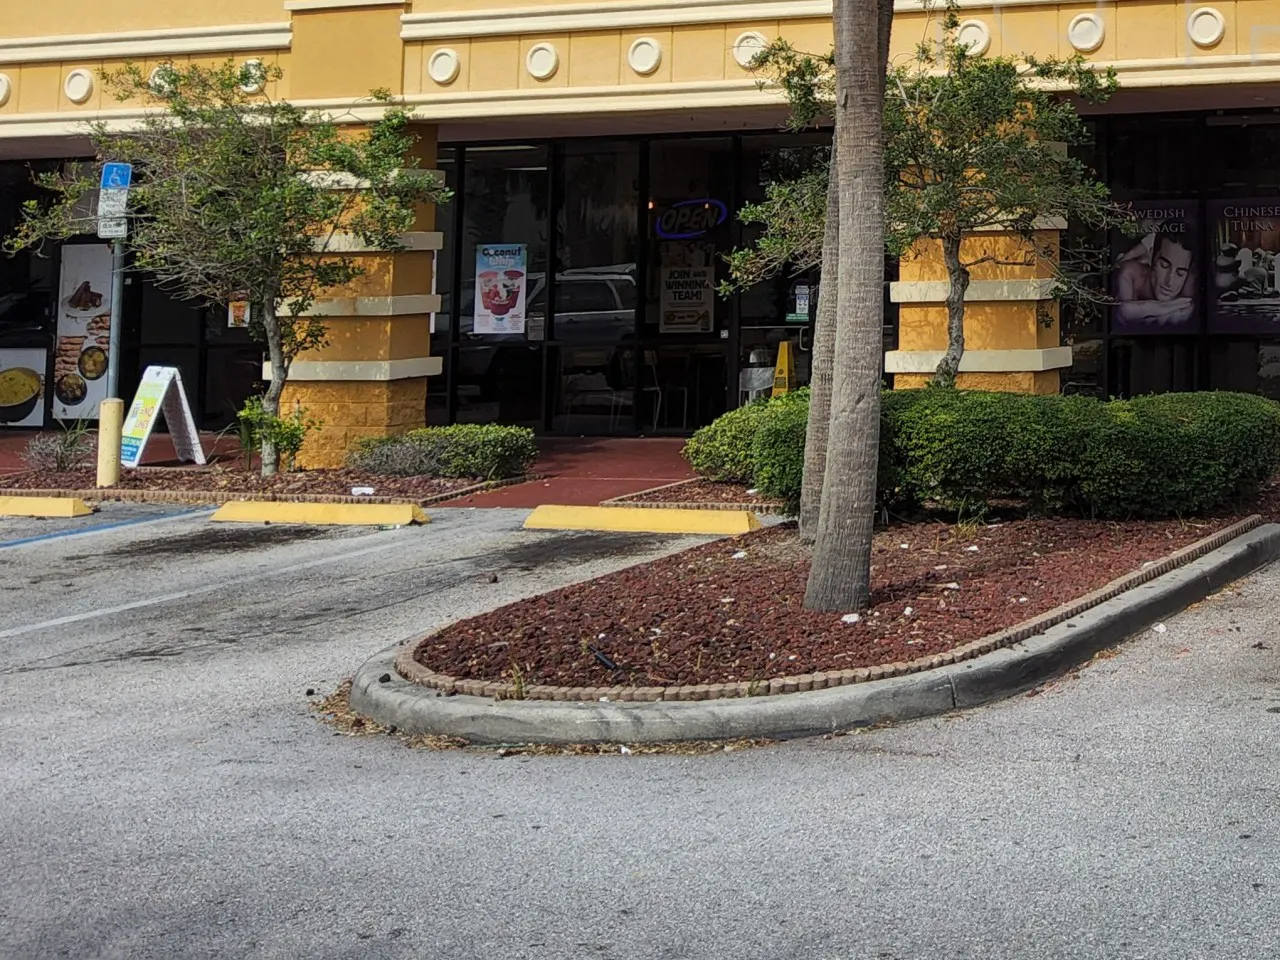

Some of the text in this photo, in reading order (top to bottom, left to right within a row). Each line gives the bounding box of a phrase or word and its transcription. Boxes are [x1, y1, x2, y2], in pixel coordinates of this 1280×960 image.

[661, 207, 718, 231] OPEN
[1130, 208, 1186, 220] WEDISH
[1232, 220, 1275, 233] TUINA
[482, 247, 521, 257] Coconut
[668, 270, 691, 280] JOIN
[673, 290, 702, 300] TEAM!
